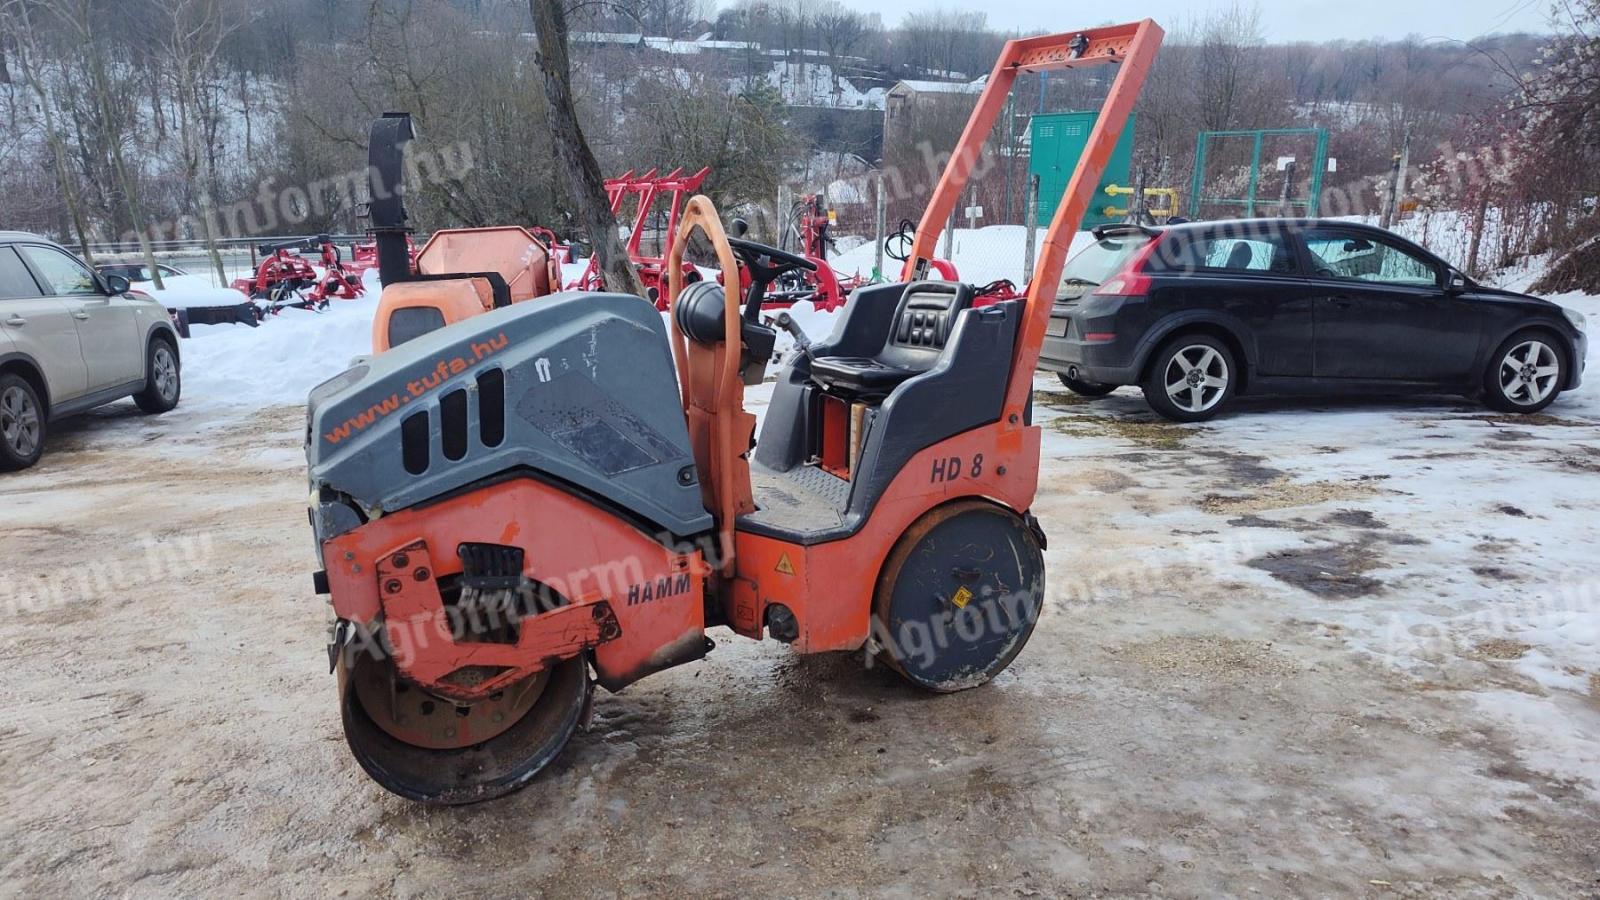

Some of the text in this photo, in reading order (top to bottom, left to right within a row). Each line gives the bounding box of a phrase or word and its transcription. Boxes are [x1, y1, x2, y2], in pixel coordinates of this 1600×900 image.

[324, 331, 508, 444] www.tufa.hu
[930, 453, 984, 483] HD 8
[627, 572, 691, 606] HAMM
